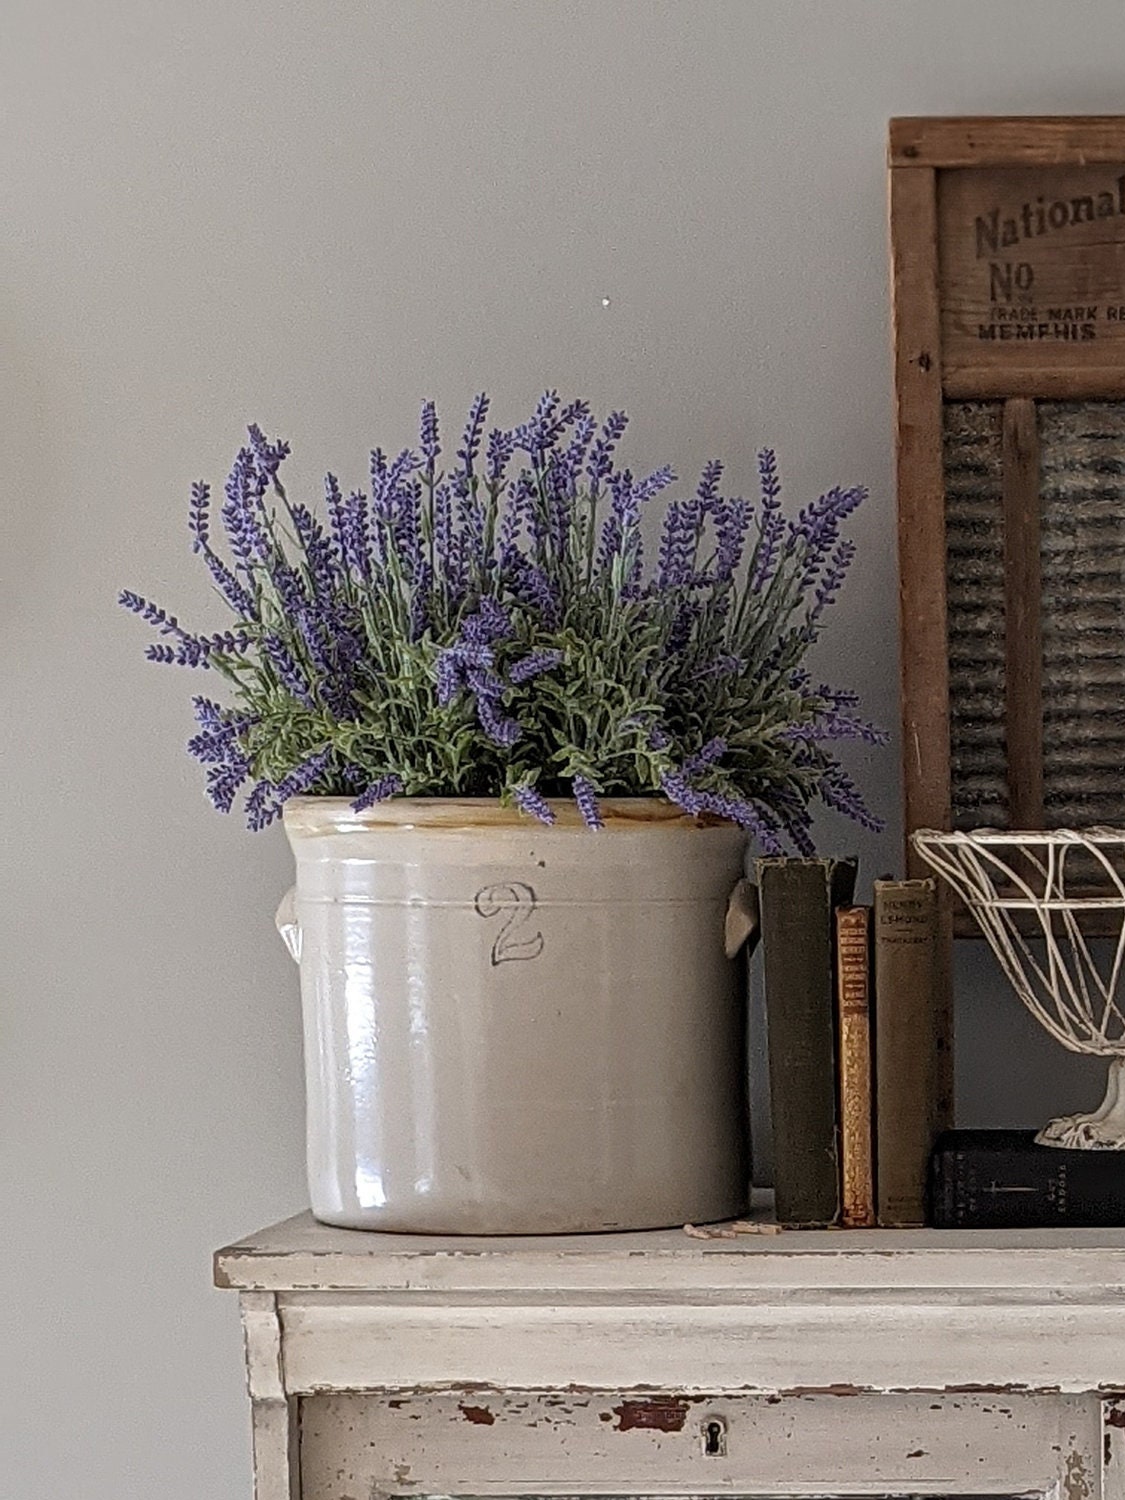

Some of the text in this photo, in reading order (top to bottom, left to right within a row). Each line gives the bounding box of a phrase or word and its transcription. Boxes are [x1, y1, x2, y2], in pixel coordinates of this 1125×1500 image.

[990, 306, 1038, 321] TRADE
[1048, 305, 1098, 321] MARK
[978, 322, 1098, 341] MEMPHIS
[474, 881, 545, 966] 2
